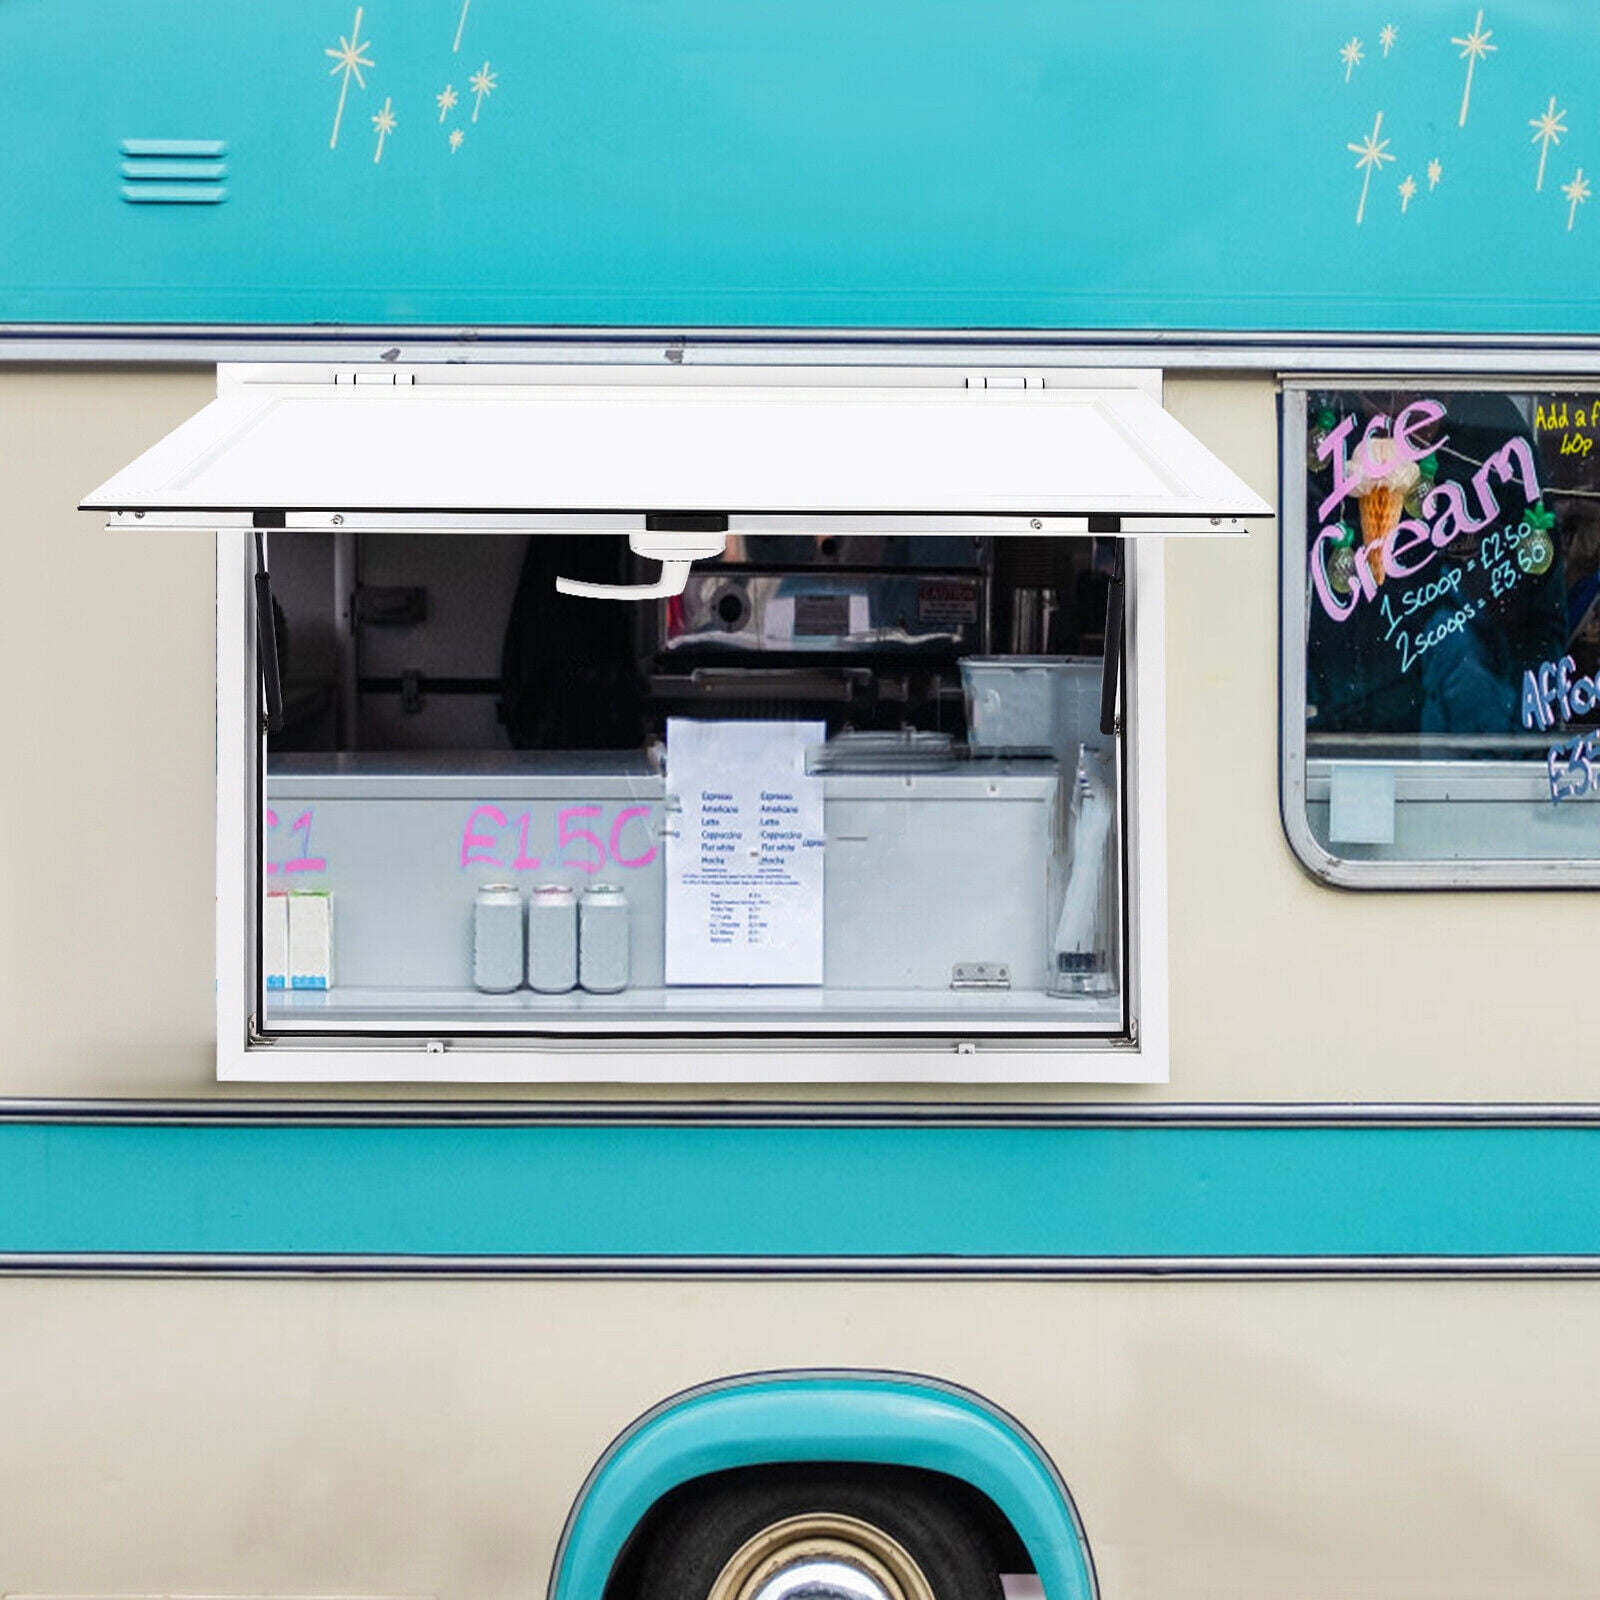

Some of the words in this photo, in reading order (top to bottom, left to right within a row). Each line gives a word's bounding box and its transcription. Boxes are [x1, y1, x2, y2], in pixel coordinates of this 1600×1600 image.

[1317, 400, 1449, 523] Ice
[1535, 402, 1569, 431] Add
[1574, 409, 1587, 428] a
[1560, 432, 1593, 457] 40p
[1311, 437, 1540, 622] Cream
[1380, 594, 1403, 641] 1
[1402, 568, 1462, 615] scoop
[1480, 522, 1531, 570] £2.50
[1395, 631, 1417, 673] 2
[1415, 603, 1476, 654] scoops
[1490, 544, 1547, 598] £3.50
[1521, 654, 1600, 732] Affo
